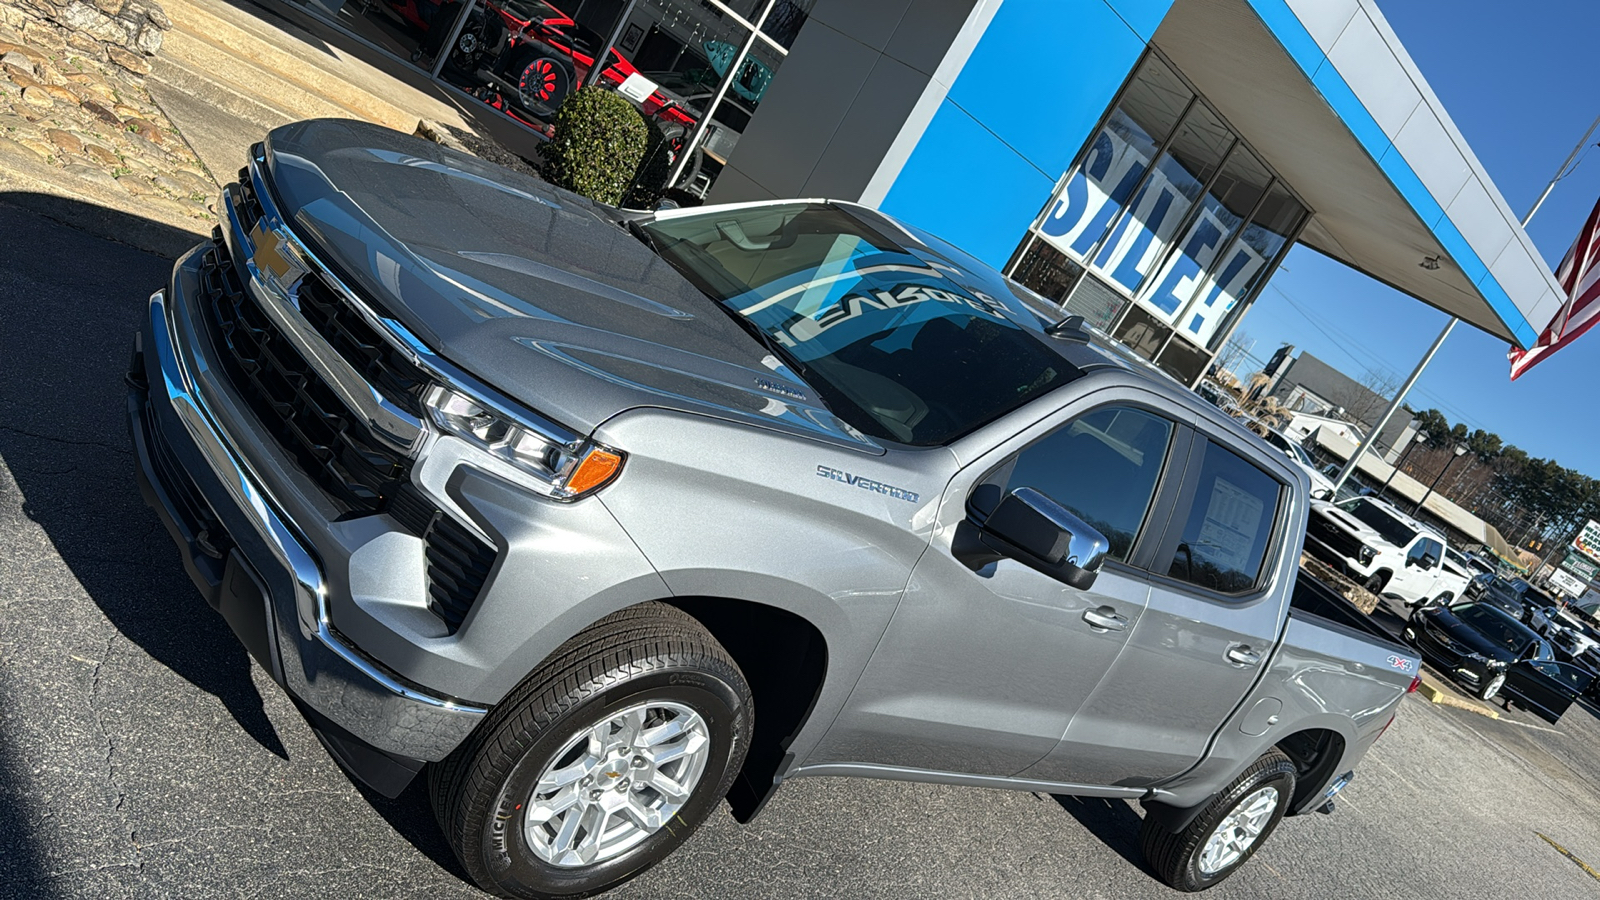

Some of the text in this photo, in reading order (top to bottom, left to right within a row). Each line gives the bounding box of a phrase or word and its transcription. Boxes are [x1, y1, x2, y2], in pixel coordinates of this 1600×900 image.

[1041, 130, 1252, 335] SALE!
[816, 465, 920, 503] SILVERADO
[492, 777, 519, 851] MICHEL
